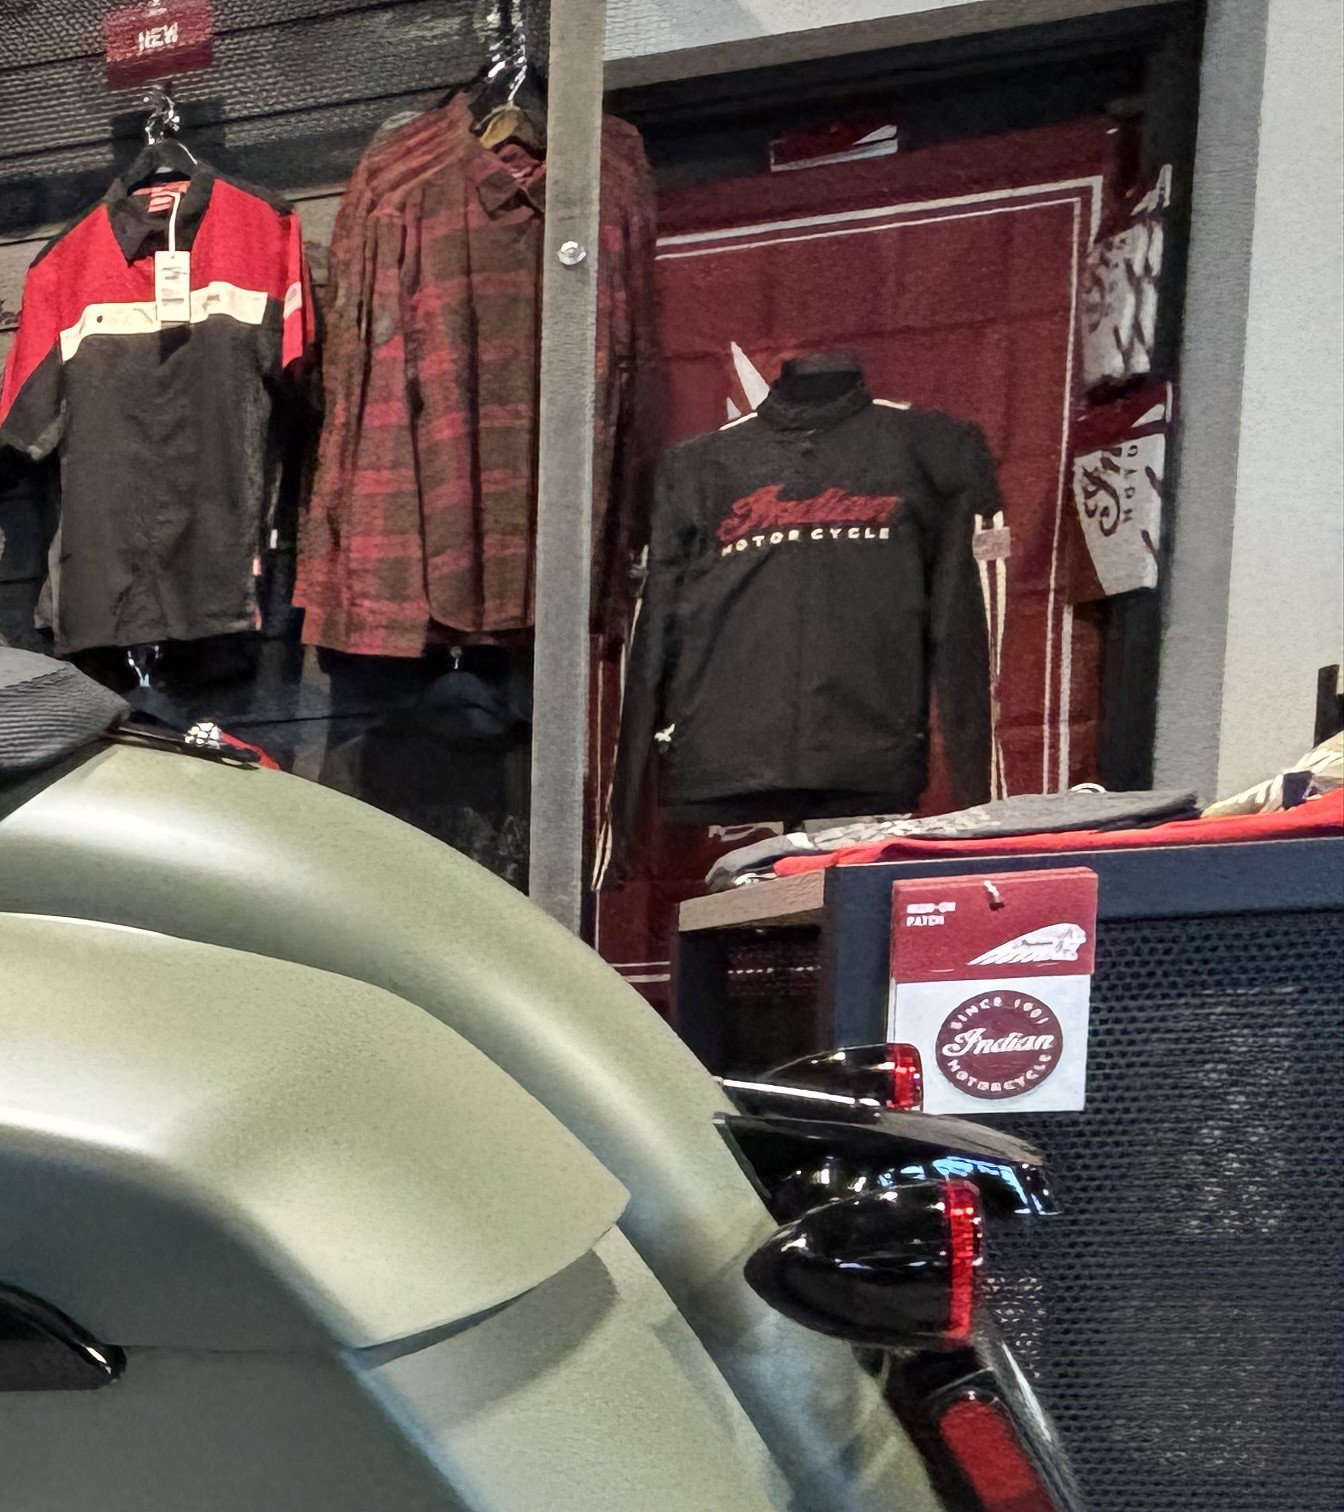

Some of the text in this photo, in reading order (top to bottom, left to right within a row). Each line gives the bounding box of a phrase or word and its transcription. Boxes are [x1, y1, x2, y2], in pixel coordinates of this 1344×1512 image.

[721, 527, 891, 557] MOTORCYCLE
[949, 996, 1050, 1031] SINCE 1901
[941, 1027, 1055, 1057] Indian
[947, 1053, 1053, 1093] MOTORCYCLE
